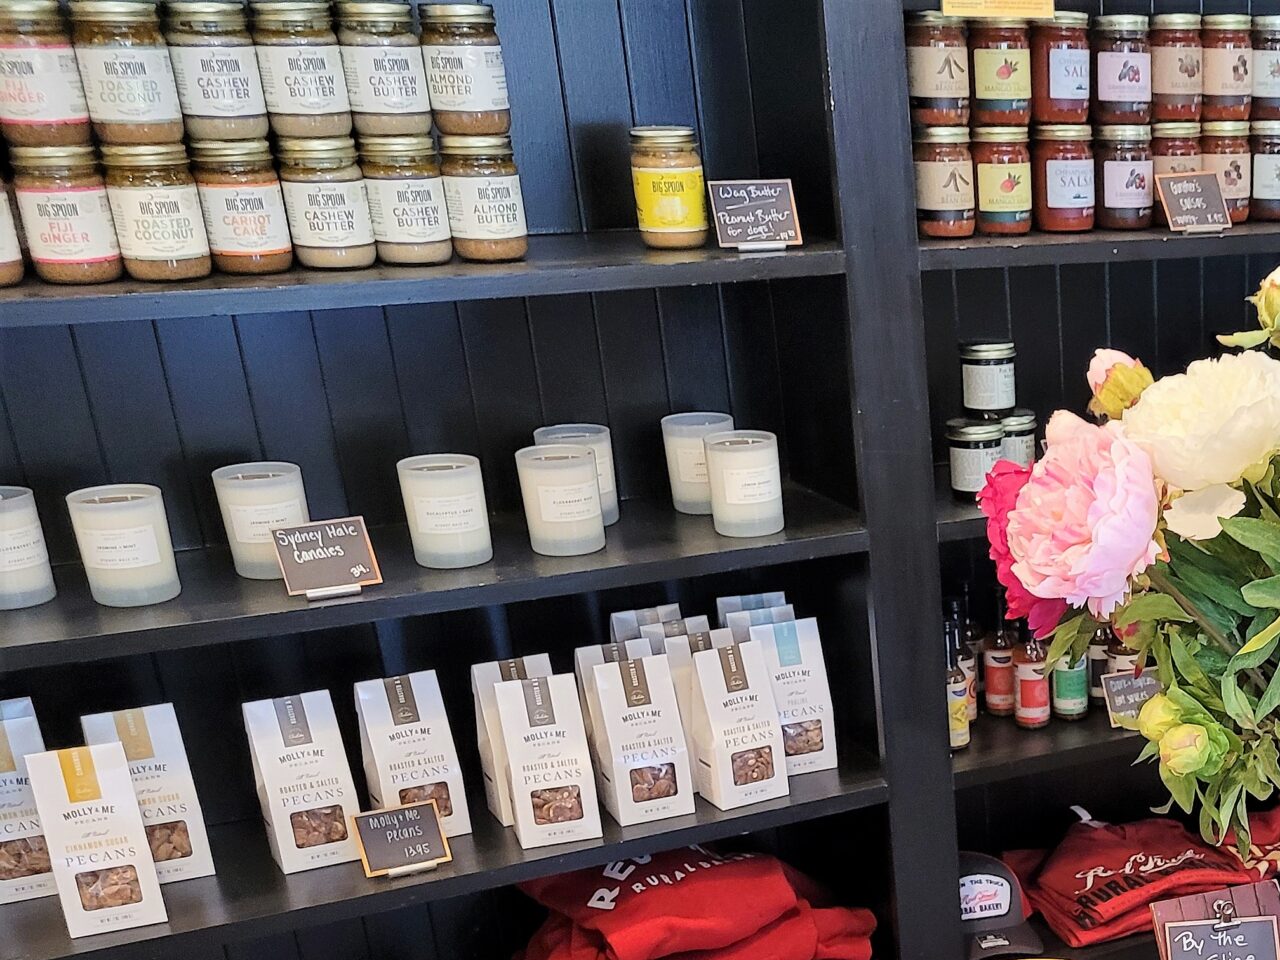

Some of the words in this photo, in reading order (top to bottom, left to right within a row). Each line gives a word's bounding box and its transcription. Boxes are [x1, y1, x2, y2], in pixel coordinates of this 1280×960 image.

[198, 76, 250, 88] CASHEW
[430, 74, 473, 86] ALMOND
[100, 91, 161, 103] COCONUT
[202, 88, 251, 99] BUTTER
[477, 187, 490, 200] BIG
[490, 187, 511, 200] SPOON
[652, 181, 663, 193] BIG
[664, 181, 685, 193] SPOON
[397, 190, 410, 203] BIG
[410, 189, 432, 202] SPOON
[719, 186, 750, 205] Wag
[747, 185, 782, 198] Butter
[392, 206, 440, 218] CASHEW
[473, 203, 518, 215] ALMOND
[222, 214, 272, 226] CARROT
[304, 210, 355, 222] CASHEW
[397, 216, 441, 228] BUTTER
[477, 213, 518, 225] BUTTER
[717, 211, 755, 225] Peanut
[755, 208, 790, 224] Butter
[49, 222, 73, 233] FIJI
[134, 218, 191, 230] TOASTED
[134, 228, 194, 241] COCONUT
[233, 225, 268, 237] CAKE
[727, 226, 743, 237] for
[40, 232, 90, 244] GINGER
[276, 529, 324, 550] Sydney
[326, 523, 358, 539] Hale
[293, 545, 345, 564] Candles
[724, 729, 775, 748] PECANS
[622, 746, 677, 764] PECANS
[389, 760, 416, 772] ROASTED
[417, 758, 423, 766] &
[423, 754, 445, 765] SALTED
[391, 764, 449, 784] PECANS
[523, 767, 583, 785] PECANS
[279, 783, 308, 795] ROASTED
[315, 777, 339, 788] SALTED
[63, 807, 94, 822] MOLLY
[101, 805, 116, 815] ME
[369, 814, 399, 830] Molly
[404, 809, 421, 821] Me
[386, 825, 423, 843] Pecans
[65, 839, 103, 854] CINNAMON
[103, 836, 129, 848] SUGAR
[631, 863, 696, 894] RURAL
[1174, 931, 1205, 955] By
[1210, 930, 1248, 946] the
